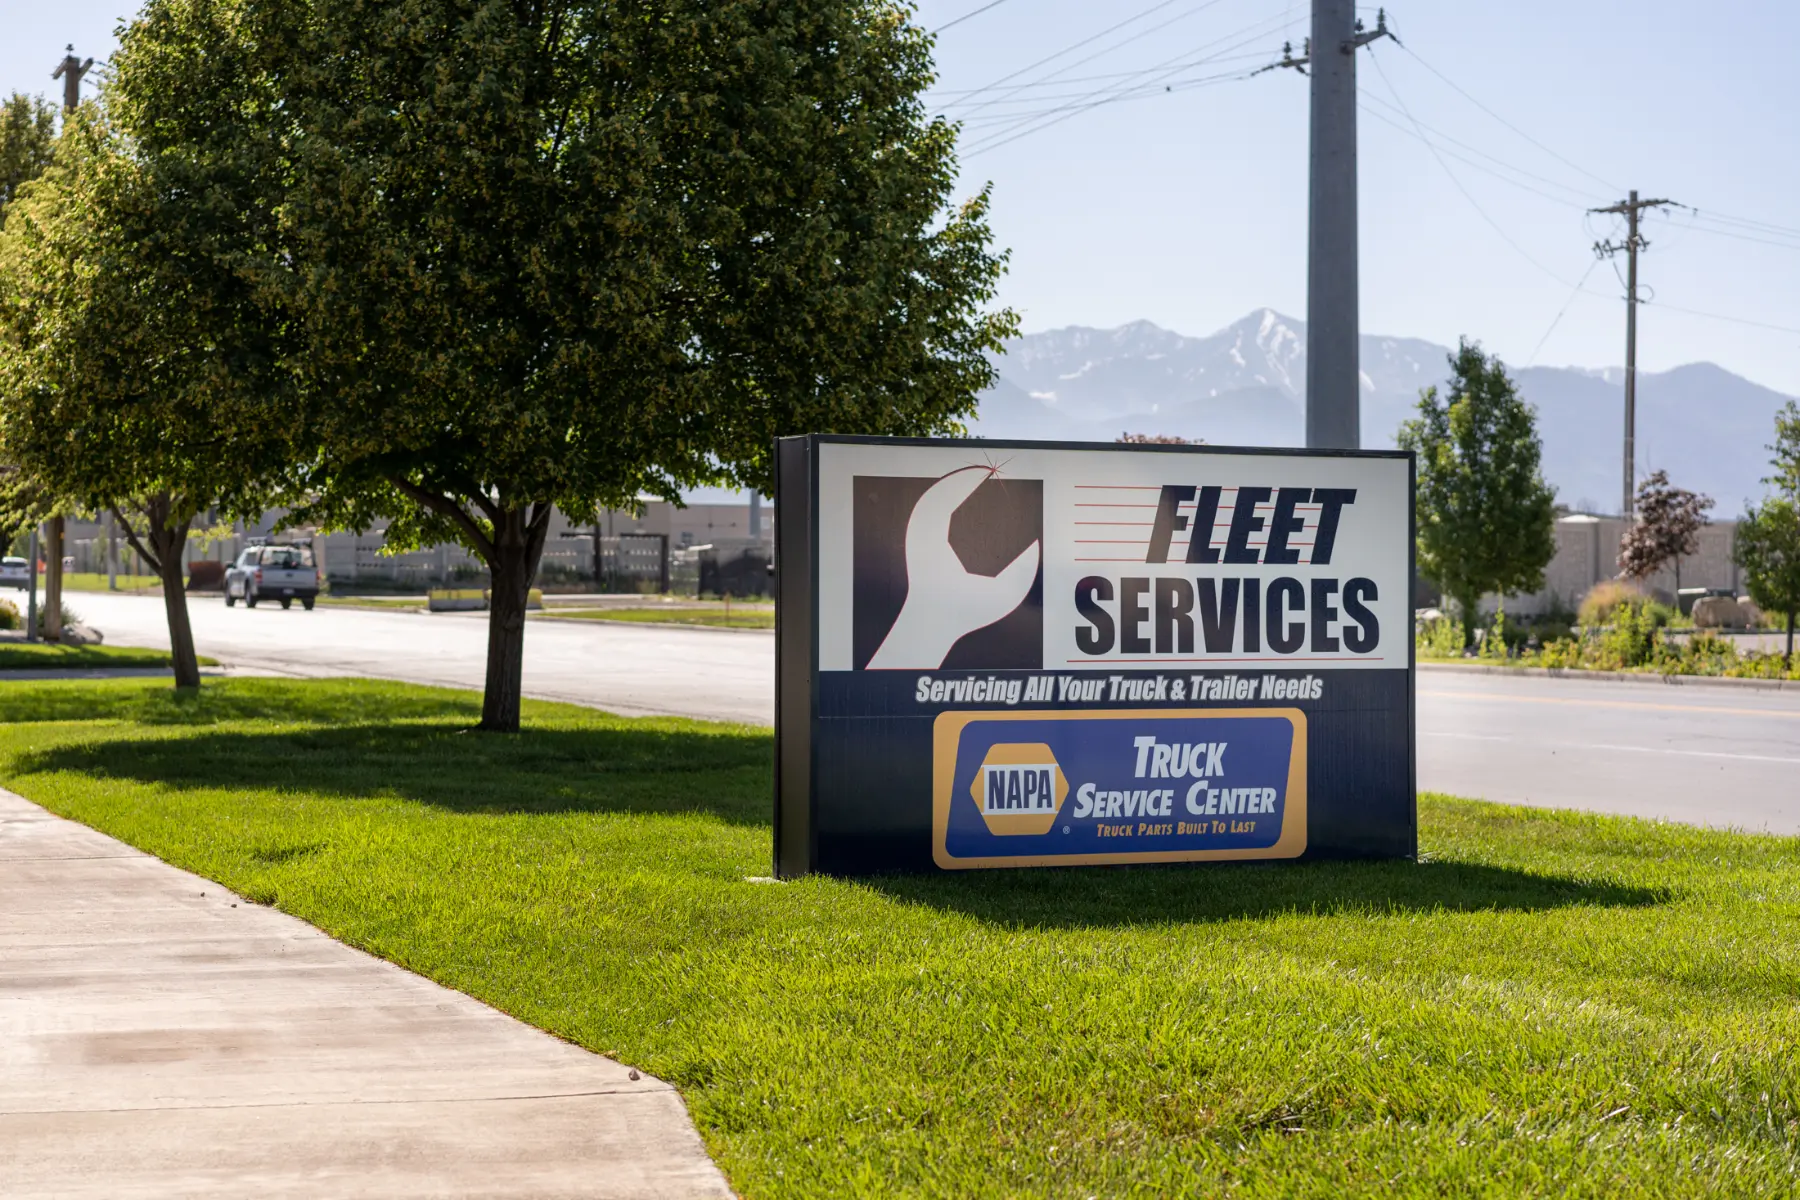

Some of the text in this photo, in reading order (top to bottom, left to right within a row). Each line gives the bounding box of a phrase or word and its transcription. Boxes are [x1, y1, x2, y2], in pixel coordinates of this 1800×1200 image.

[1145, 485, 1357, 565] FLEET
[1074, 575, 1380, 655] SERVICES
[915, 674, 1324, 705] Servicing All Your Truck & Trailer Needs
[988, 769, 1053, 809] NAPA
